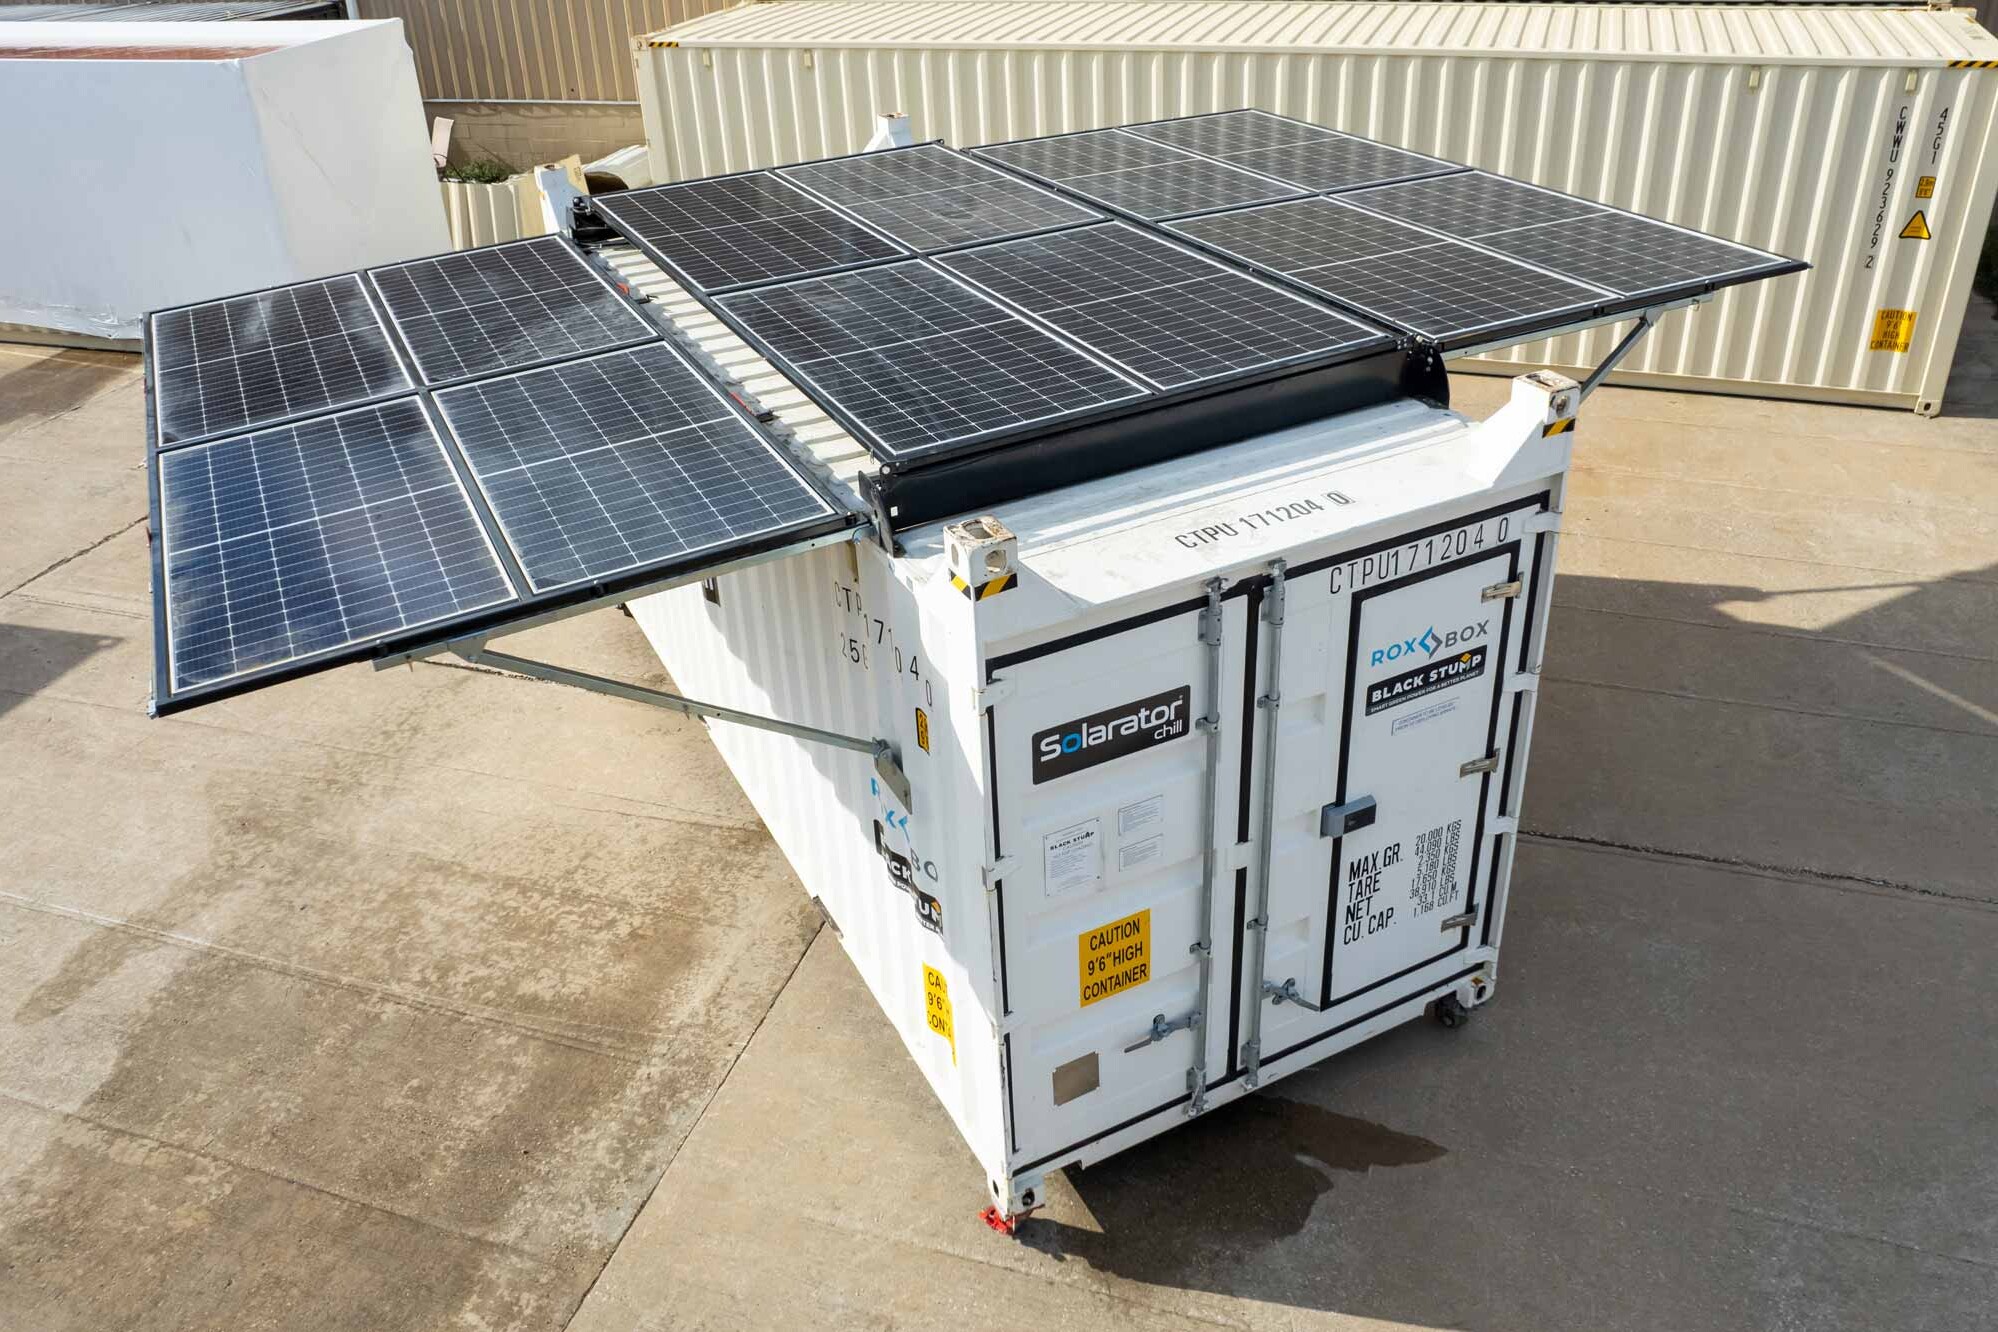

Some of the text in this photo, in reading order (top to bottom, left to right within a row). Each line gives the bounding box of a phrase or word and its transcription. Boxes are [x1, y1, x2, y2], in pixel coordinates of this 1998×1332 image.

[1889, 106, 1908, 163] CWWU
[1881, 311, 1913, 321] CAUTION
[1870, 340, 1910, 352] CONTAINER
[1174, 522, 1238, 548] CTPU
[1239, 499, 1325, 535] 171204
[1497, 517, 1509, 542] 0
[1371, 619, 1489, 667] ROX BOX
[1371, 654, 1482, 703] BLACK STUMP
[1040, 699, 1183, 762] Solarator
[1154, 719, 1183, 740] chill
[1445, 831, 1460, 845] LBS
[1447, 820, 1462, 833] KGS
[1442, 852, 1457, 866] LBS
[1444, 841, 1459, 855] KGS
[1440, 873, 1455, 887] LBS
[1441, 862, 1456, 876] KGS
[1348, 871, 1382, 902] TARE
[1345, 895, 1373, 925] NET
[1368, 907, 1397, 935] CAP.
[1089, 918, 1140, 951] CAUTION
[1083, 963, 1147, 1001] CONTAINER
